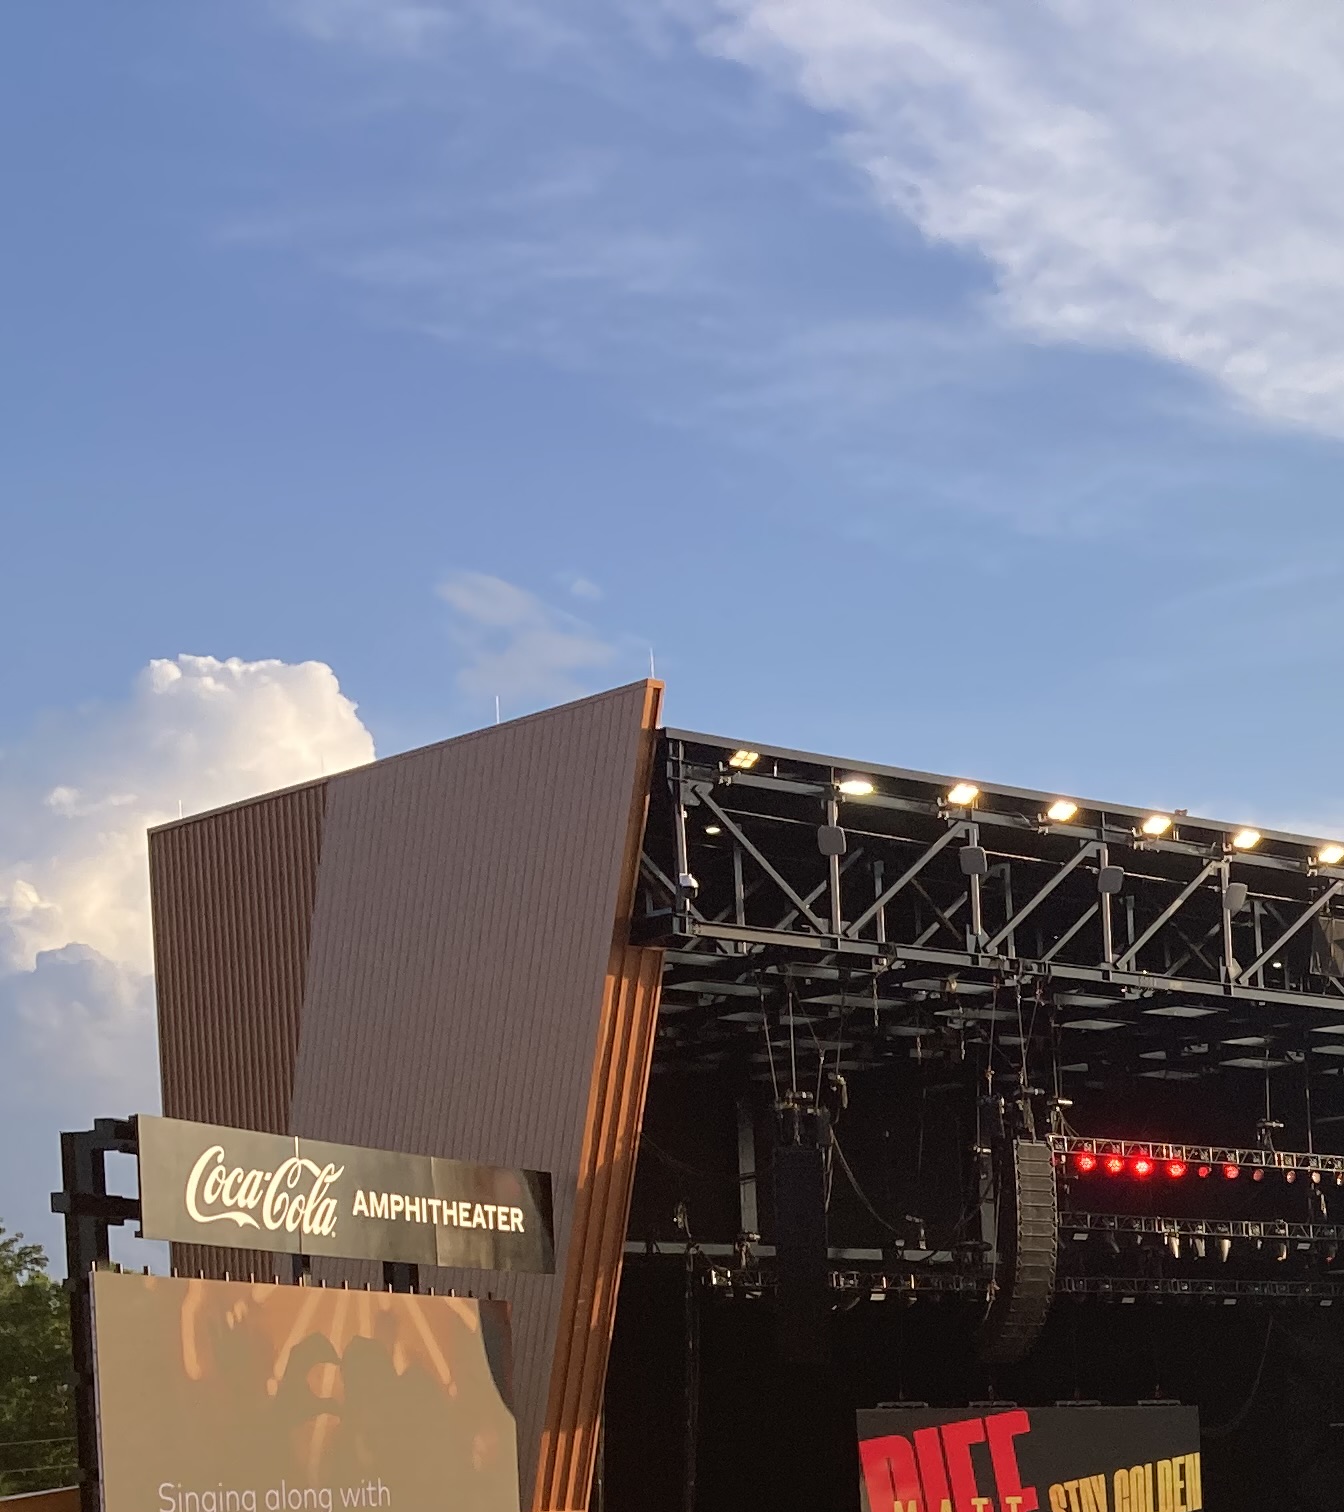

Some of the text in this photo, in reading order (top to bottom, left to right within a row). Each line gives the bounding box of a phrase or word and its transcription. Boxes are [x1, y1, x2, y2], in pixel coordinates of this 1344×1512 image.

[186, 1145, 525, 1238] Coca-Cola AMPHITHEATER
[339, 1477, 391, 1508] with
